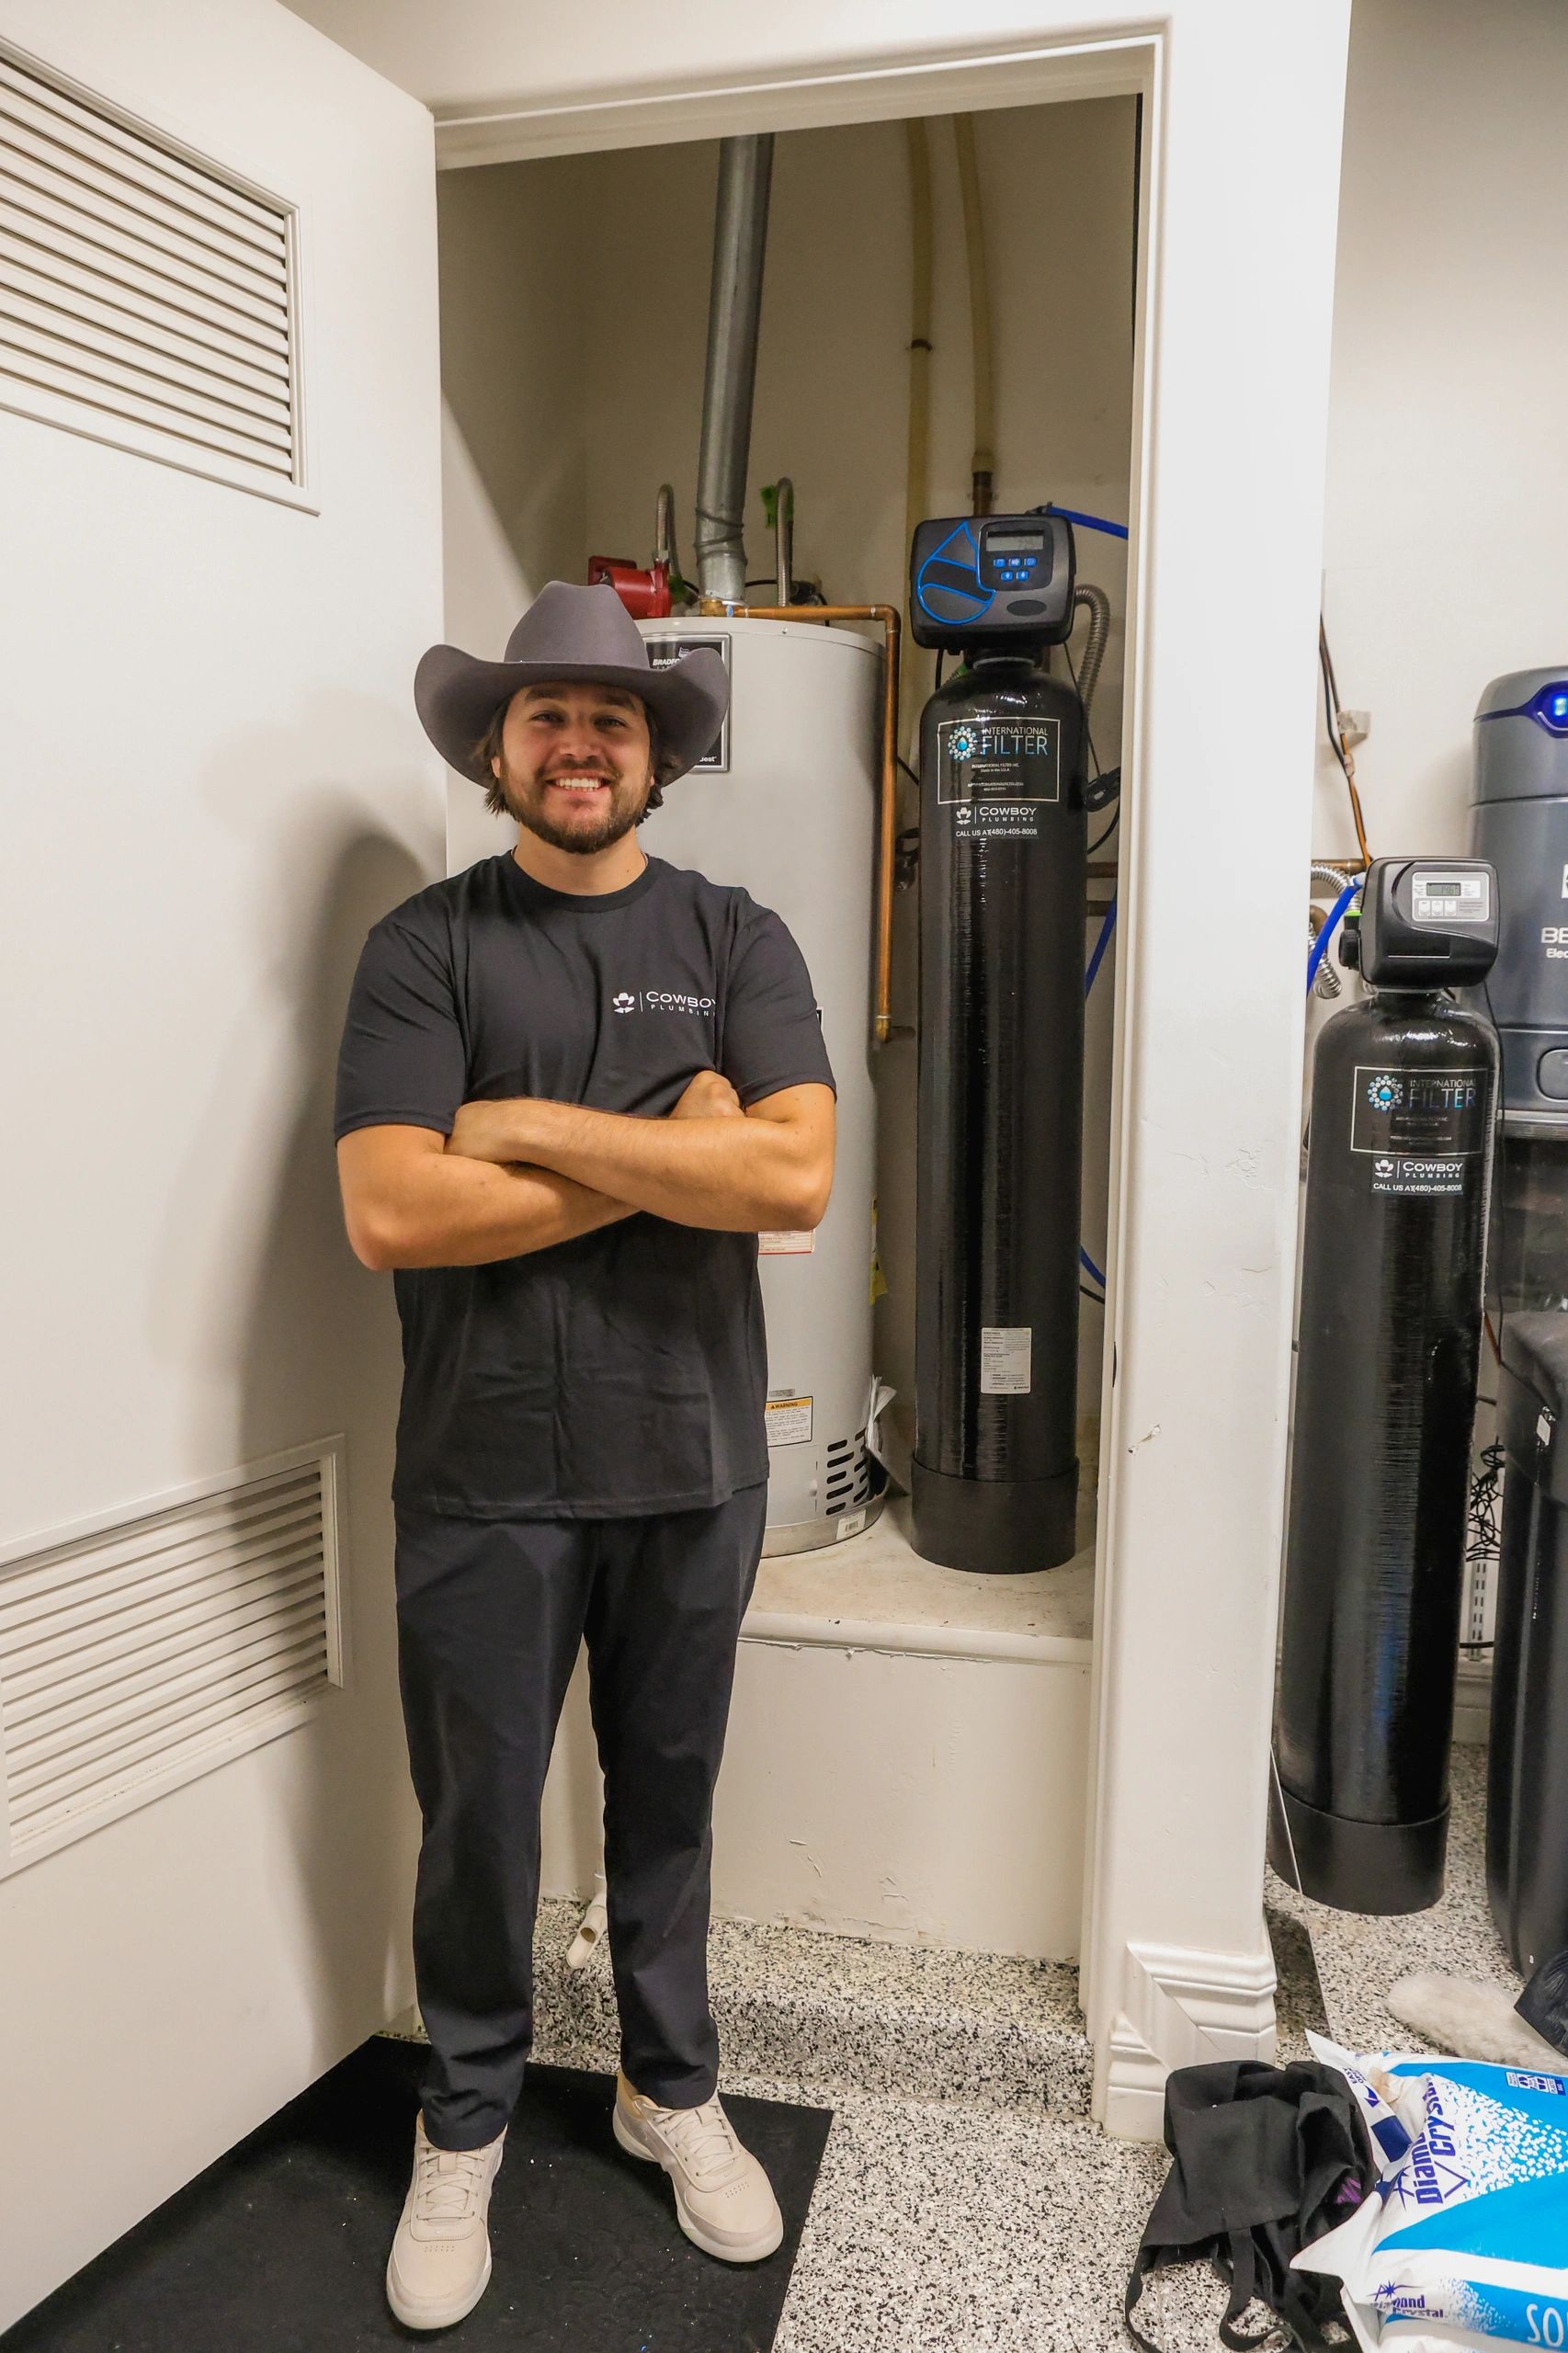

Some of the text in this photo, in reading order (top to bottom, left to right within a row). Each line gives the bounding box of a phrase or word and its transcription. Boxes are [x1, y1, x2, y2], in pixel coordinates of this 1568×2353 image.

[983, 727, 1048, 735] INTERNATIONAL
[983, 735, 1048, 756] FILTER
[979, 807, 1037, 815] COWBOY
[651, 1004, 715, 1017] PLUMBIN
[1410, 1079, 1476, 1087] INTERNATIONAL
[1409, 1088, 1476, 1109] FILTER
[1403, 1162, 1463, 1171] COWBOY
[1422, 2081, 1456, 2156] Crys
[1411, 2132, 1444, 2204] Diam
[1526, 2303, 1568, 2347] SO
